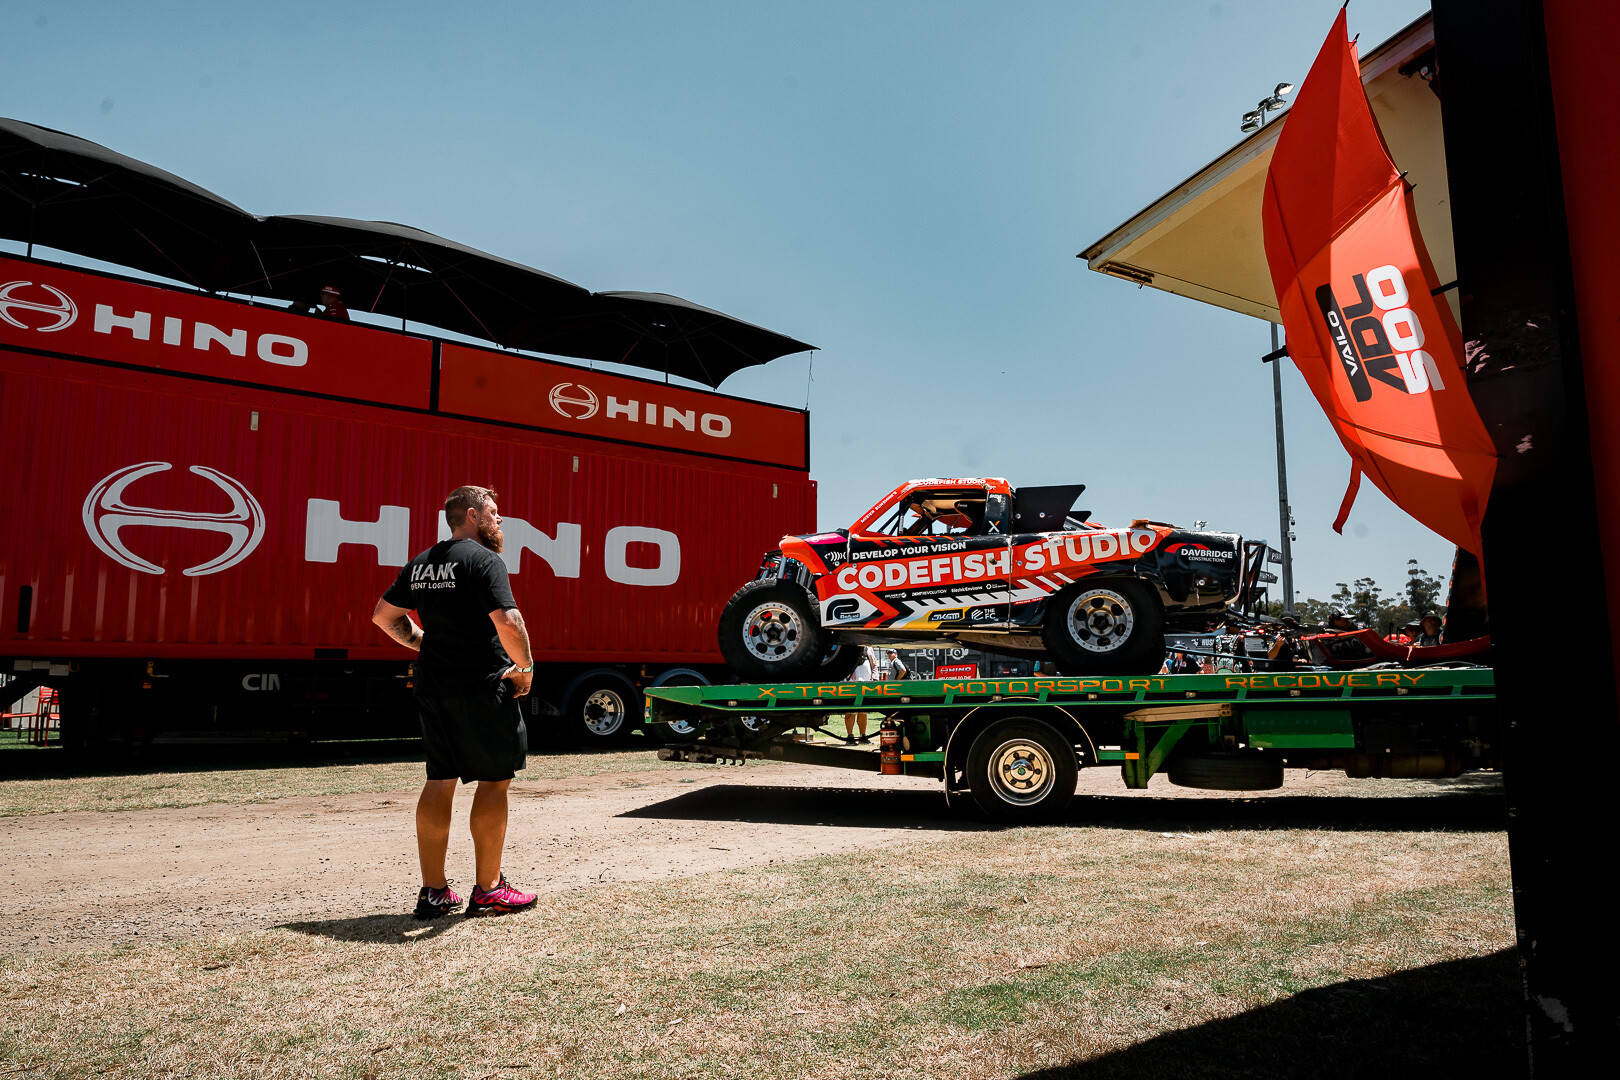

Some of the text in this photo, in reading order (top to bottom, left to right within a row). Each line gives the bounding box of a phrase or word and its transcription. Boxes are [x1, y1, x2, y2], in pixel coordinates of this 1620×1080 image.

[94, 303, 308, 367] HINO
[1327, 310, 1359, 377] VAILO
[1366, 264, 1446, 395] 500
[606, 395, 732, 438] HINO
[305, 498, 681, 586] HNO
[837, 530, 1157, 592] CODEFISH STUDIO
[852, 541, 967, 561] DEVELOP YOUR VISION
[1181, 548, 1233, 559] DAVBRIDGE
[1188, 556, 1226, 564] CONSTRUCTIONS
[410, 561, 459, 583] HANK
[757, 673, 1426, 699] X-TREME MOTORSPORT RECOVERY
